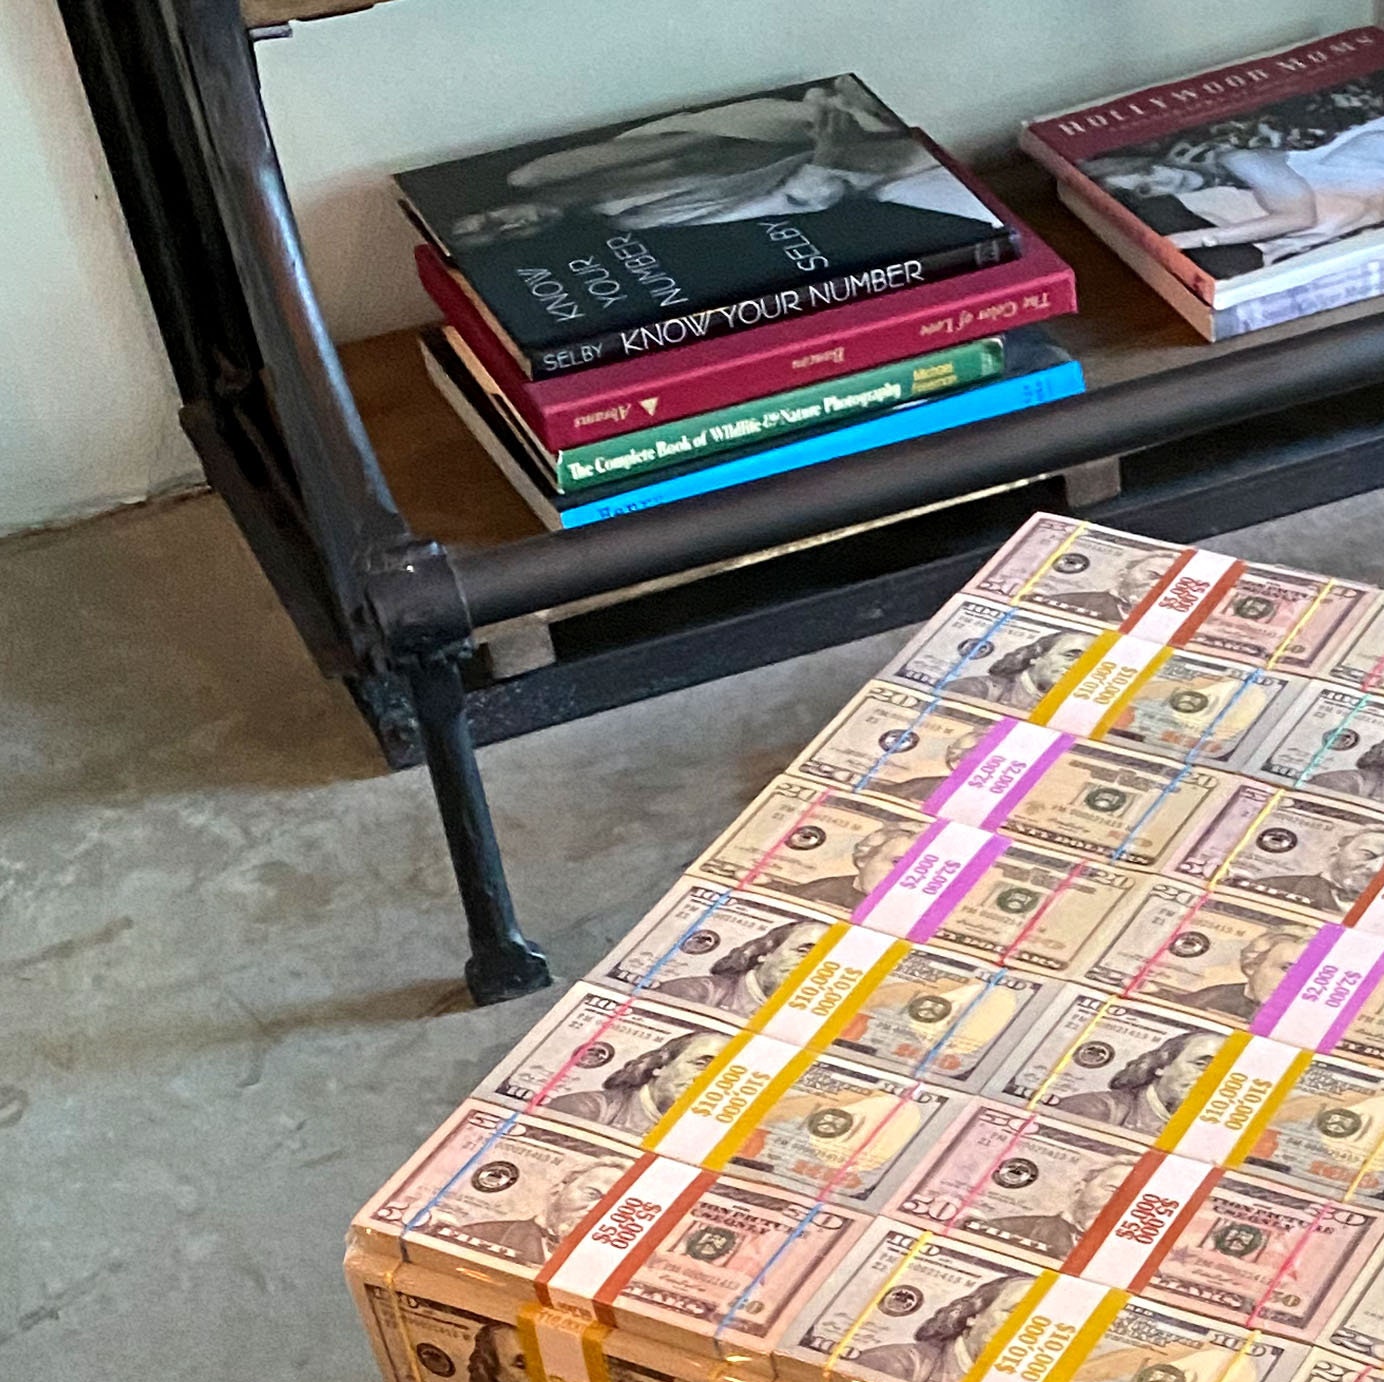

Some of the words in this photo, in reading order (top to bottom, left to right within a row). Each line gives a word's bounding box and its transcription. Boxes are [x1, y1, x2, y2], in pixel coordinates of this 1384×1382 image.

[758, 220, 828, 271] SELBY
[569, 255, 627, 308] YOUR
[607, 232, 688, 306] NUMBER
[517, 267, 584, 322] KNOW
[620, 311, 711, 354] KNOW
[717, 290, 803, 328] YOUR
[808, 260, 925, 307] NUMBER
[978, 299, 1018, 320] Color
[1023, 291, 1050, 309] The
[919, 318, 954, 336] Love
[958, 311, 975, 331] of
[544, 342, 607, 371] SELBY
[567, 463, 595, 481] The
[594, 447, 657, 473] Complete
[655, 435, 692, 458] Book
[692, 429, 708, 447] of
[709, 416, 762, 442] Wildlife
[780, 403, 822, 425] Nature
[822, 381, 902, 415] Photography
[574, 403, 632, 428] Abrams
[1072, 660, 1117, 700] $10,000
[1092, 666, 1137, 705] $10,000
[967, 754, 1007, 788] $2,000
[986, 760, 1026, 794] $2,000
[899, 853, 940, 889] $2,000
[921, 860, 963, 896] $2,000
[786, 960, 840, 1010] $10,000
[809, 967, 864, 1017] $10,000
[1301, 964, 1340, 1002] $2,000
[1324, 970, 1363, 1008] $2,000
[690, 1063, 747, 1116] $10,000
[714, 1071, 770, 1124] $10,000
[1198, 1071, 1249, 1123] $10,000
[1222, 1078, 1272, 1131] $10,000
[465, 1110, 529, 1139] 50
[975, 1108, 1042, 1137] 50
[377, 1199, 435, 1229] 50
[590, 1196, 644, 1244] $5,000
[608, 1201, 663, 1250] $5,000
[901, 1191, 961, 1224] 50
[1114, 1192, 1164, 1241] $5,000
[1132, 1197, 1179, 1245] $5,000
[436, 1225, 521, 1259] FIFTY
[964, 1219, 1054, 1253] FIFTY
[992, 1314, 1052, 1375] $10,000
[1019, 1322, 1076, 1382] $10,000
